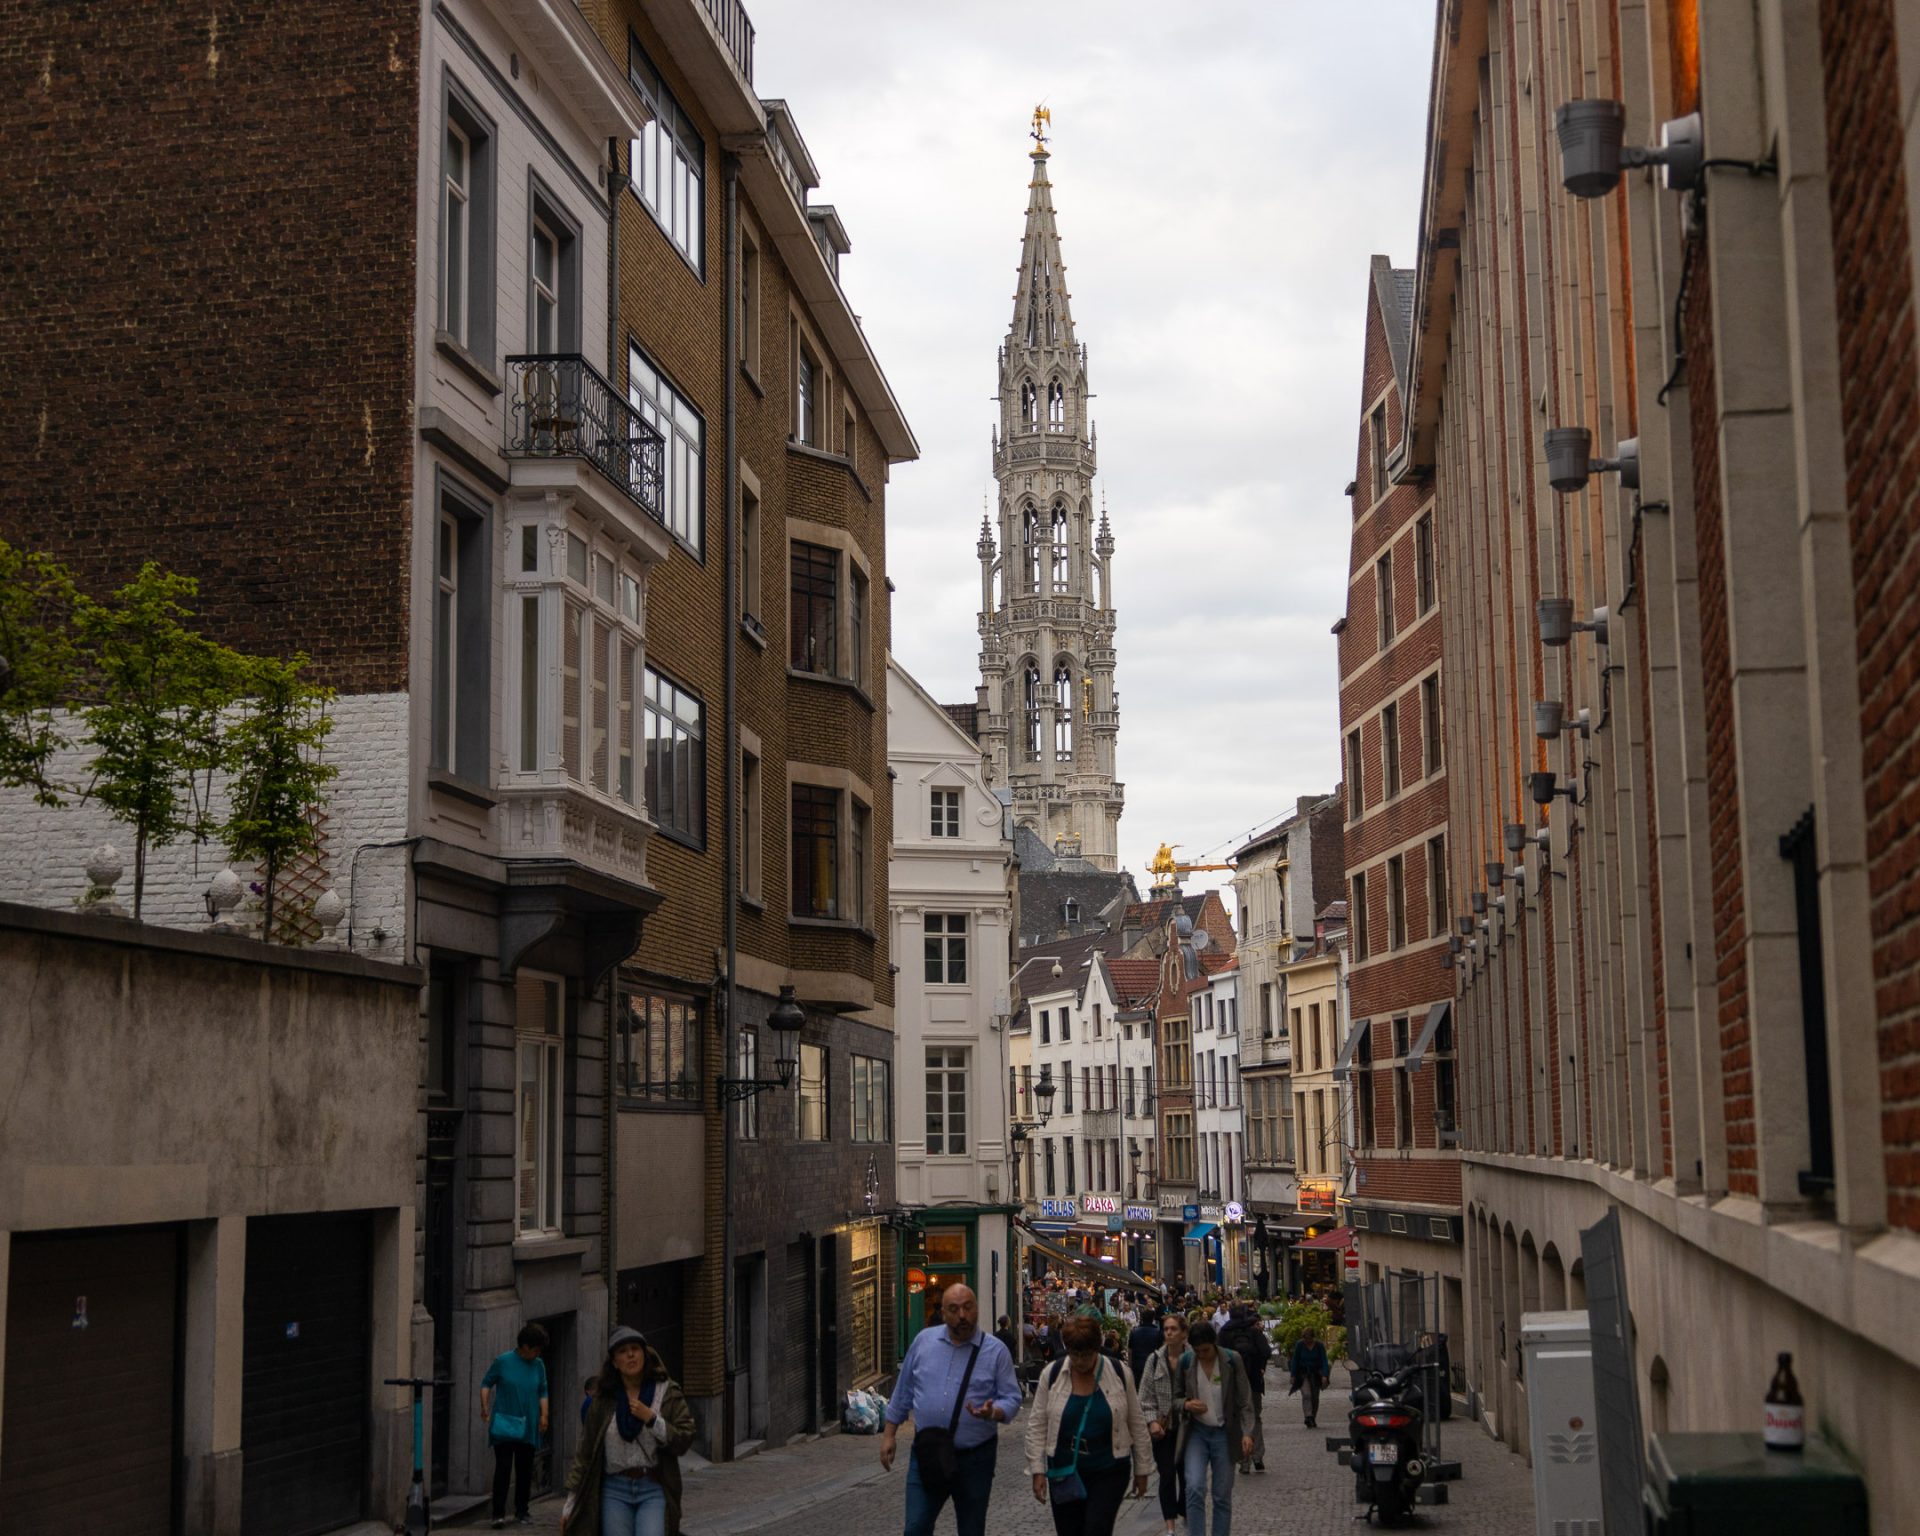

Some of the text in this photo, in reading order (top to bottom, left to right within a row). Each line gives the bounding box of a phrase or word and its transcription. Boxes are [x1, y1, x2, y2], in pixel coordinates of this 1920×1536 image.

[1042, 1200, 1075, 1216] HELLAS
[1086, 1197, 1115, 1212] PLAKA
[1127, 1205, 1152, 1220] MYKONOS
